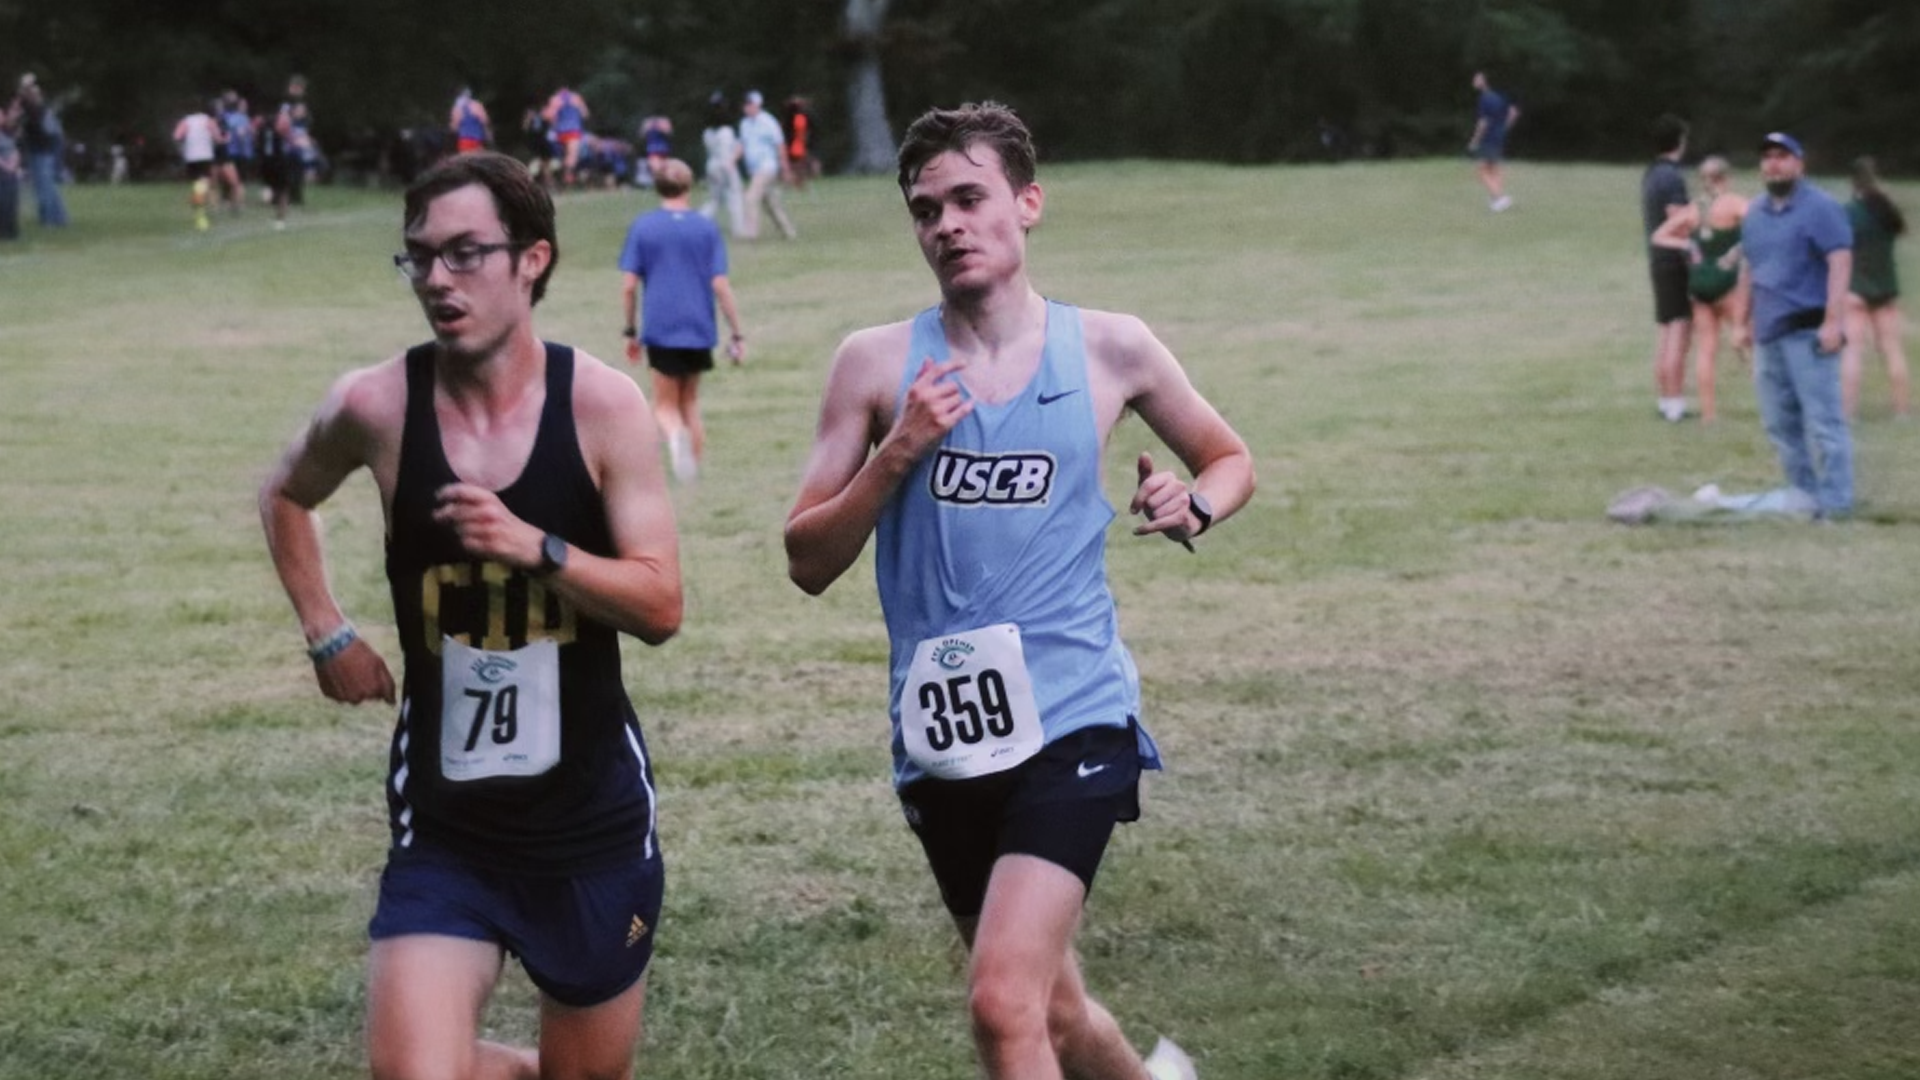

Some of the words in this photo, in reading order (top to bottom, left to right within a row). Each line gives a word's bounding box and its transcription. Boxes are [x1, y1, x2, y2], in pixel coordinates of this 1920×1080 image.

[931, 450, 1054, 505] USCB
[463, 684, 518, 752] 79
[919, 668, 1014, 752] 359
